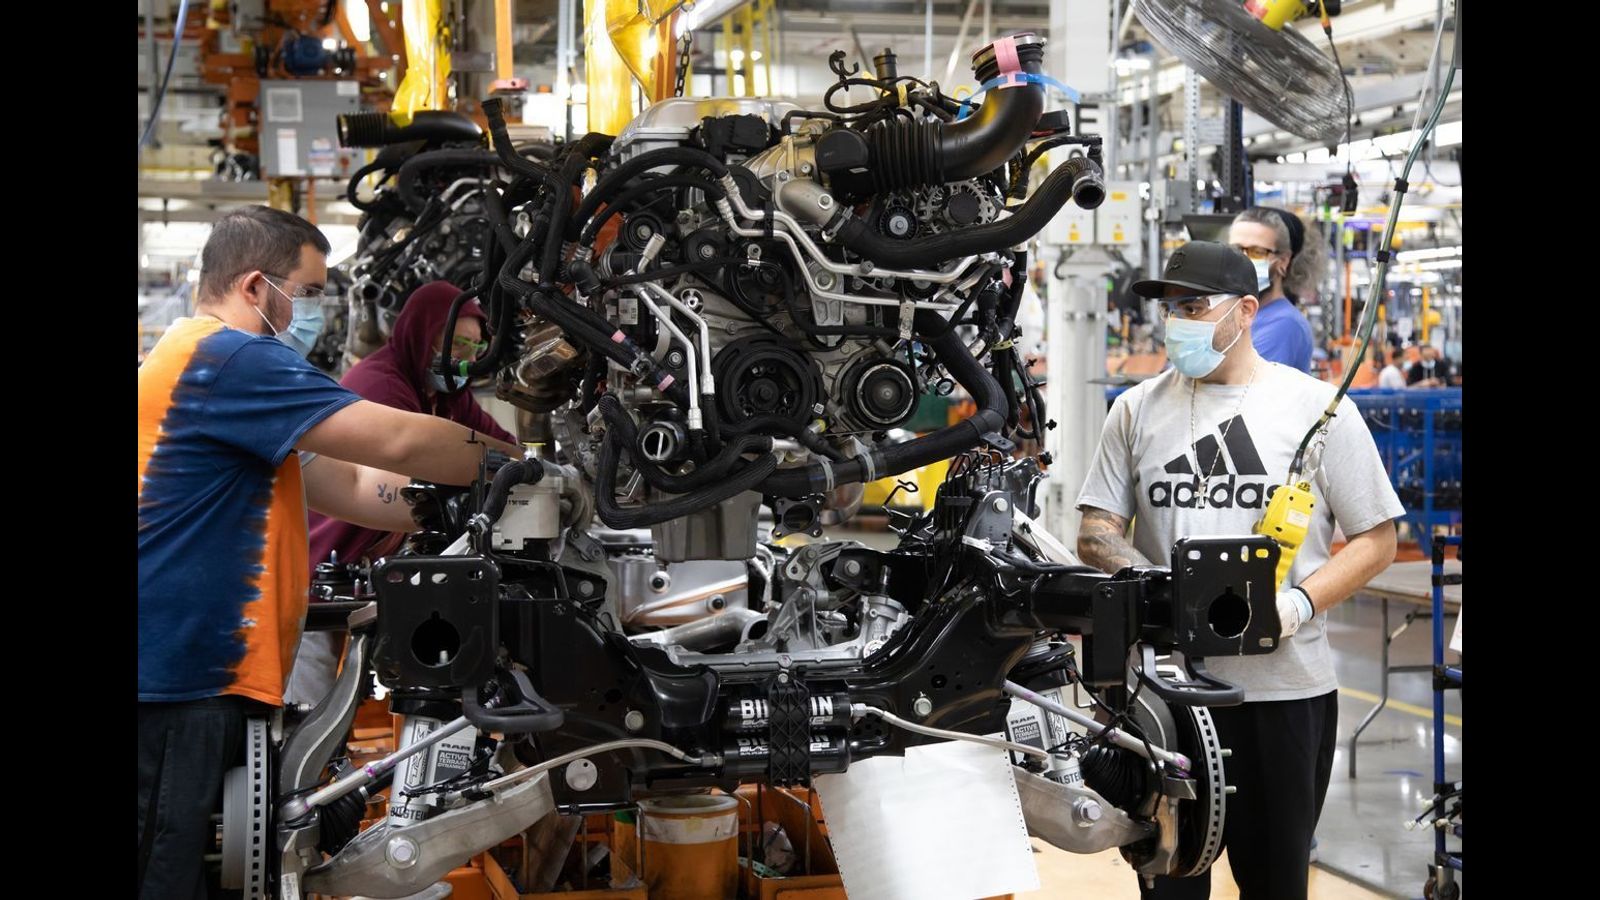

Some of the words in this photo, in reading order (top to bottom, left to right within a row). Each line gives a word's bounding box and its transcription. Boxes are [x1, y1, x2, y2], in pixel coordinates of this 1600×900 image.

[740, 696, 833, 719] BILIN
[441, 743, 471, 751] RAM
[439, 752, 468, 761] ACTIVE
[438, 758, 467, 766] TERRAIN
[390, 806, 425, 821] BILSTEI
